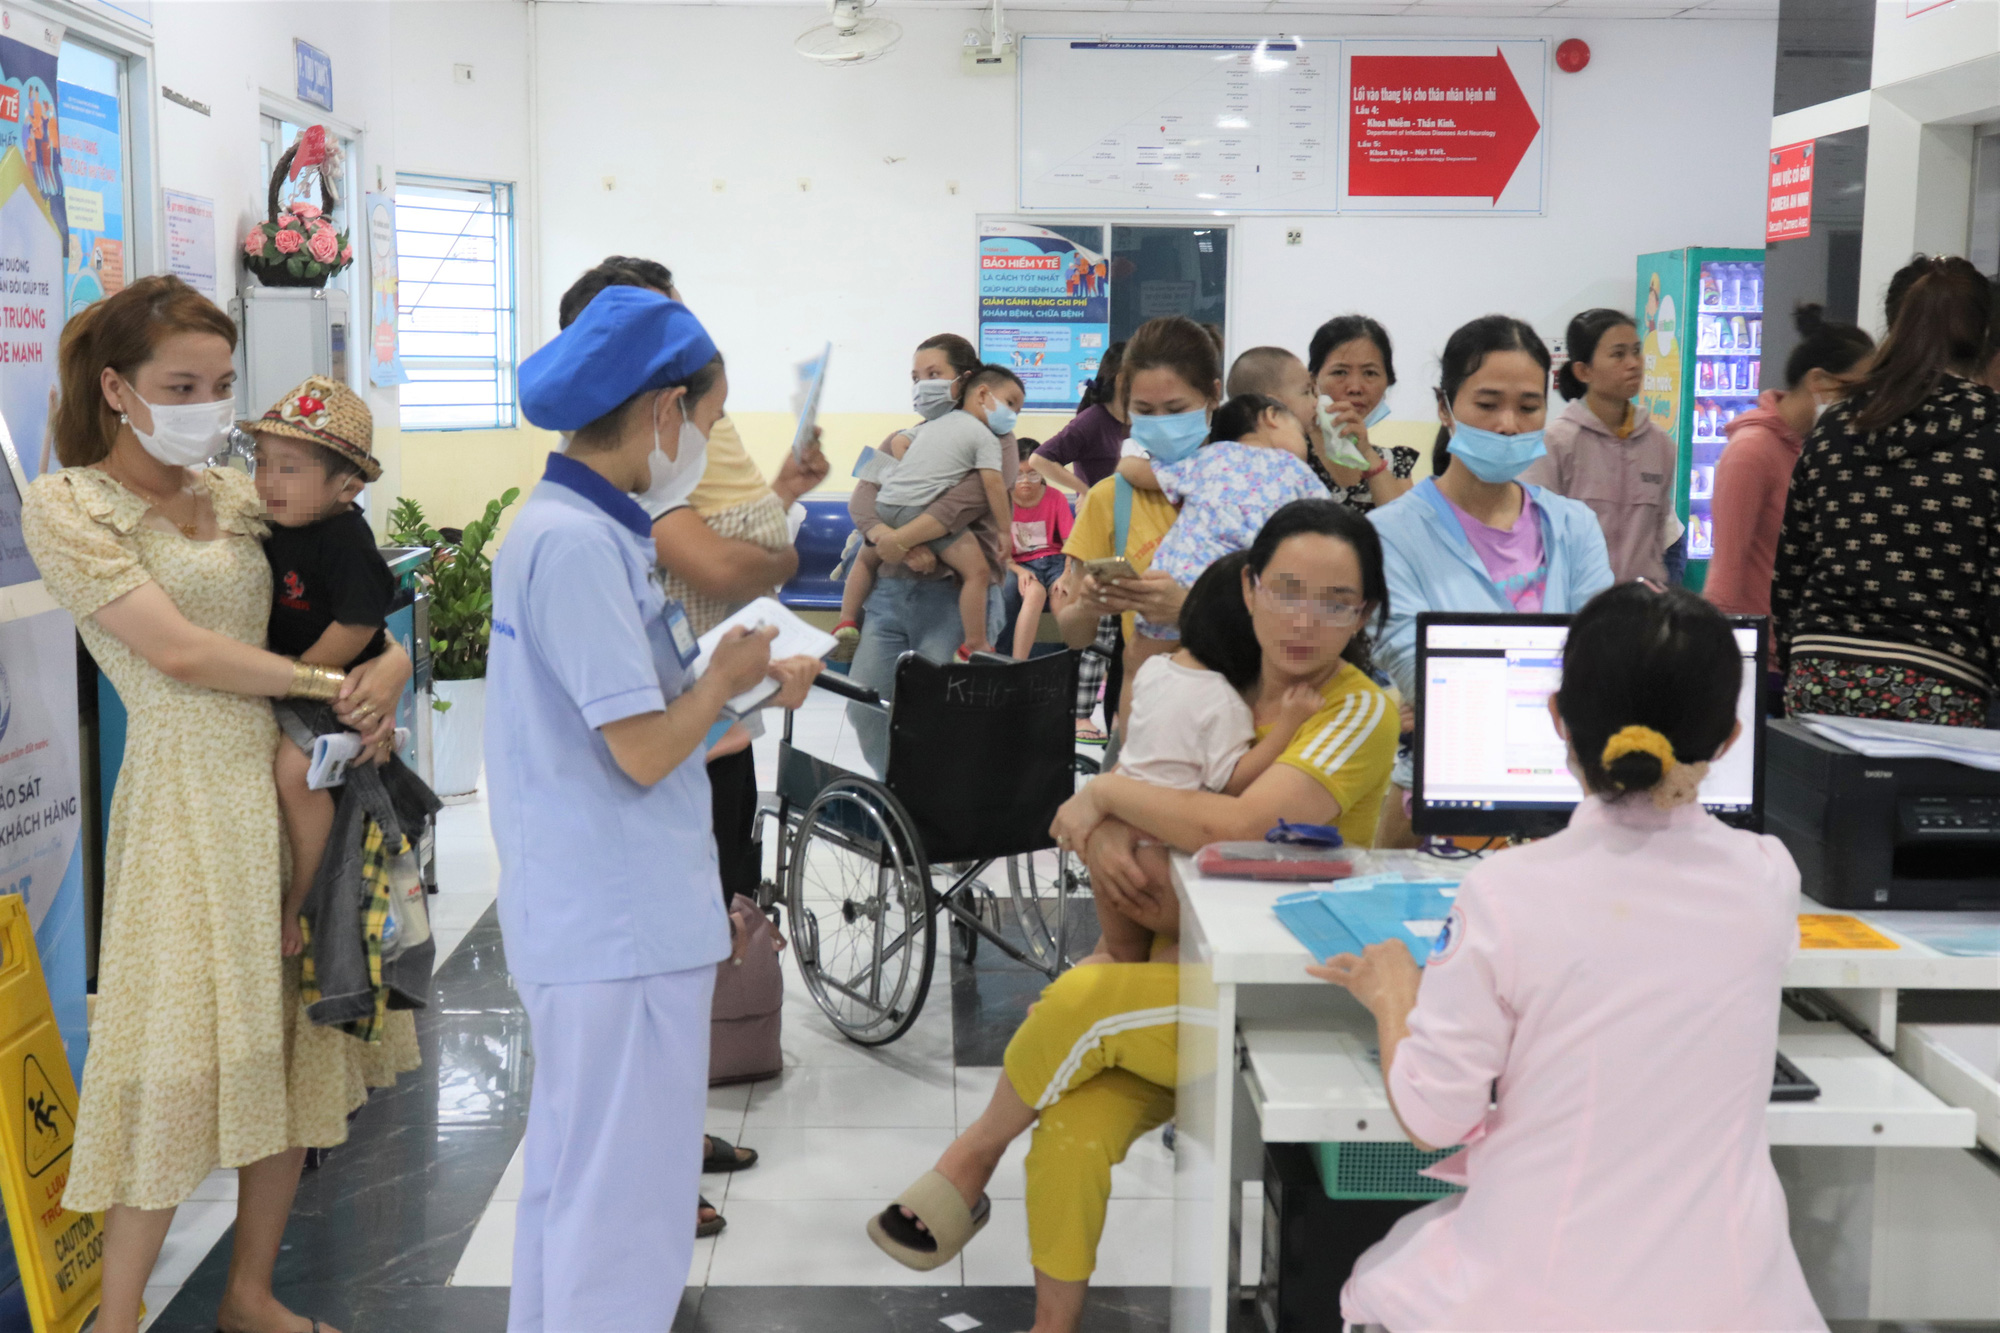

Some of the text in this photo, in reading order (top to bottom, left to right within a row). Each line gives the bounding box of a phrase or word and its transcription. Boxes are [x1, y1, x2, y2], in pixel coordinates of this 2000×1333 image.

[1367, 87, 1379, 101] vào
[1380, 87, 1401, 104] thang
[1403, 87, 1412, 104] bộ
[1413, 87, 1427, 101] cho
[1428, 87, 1445, 101] thân
[1446, 87, 1464, 101] nhân
[1465, 87, 1483, 104] bệnh
[1484, 87, 1496, 101] nhi
[5, 90, 18, 118] TẾ
[1371, 105, 1379, 114] 4:
[1367, 119, 1386, 127] Khoa
[1387, 117, 1411, 127] Nhiễm
[1437, 119, 1456, 127] Kinh.
[1469, 130, 1496, 138] Neurology
[1770, 194, 1790, 212] CAMERA
[1790, 193, 1797, 209] AN
[982, 256, 1059, 268] BẢO HIỂM Y TẾ
[995, 272, 1018, 281] CÁCH
[22, 279, 37, 295] GIÚP
[982, 284, 1001, 293] GIÚP
[1002, 284, 1027, 293] NGƯỜI
[1028, 284, 1049, 294] BỆNH
[982, 298, 1004, 306] GIẢM
[1005, 298, 1030, 306] GÁNH
[1031, 298, 1055, 307] NẶNG
[1073, 298, 1088, 306] PHÍ
[982, 309, 1007, 317] KHÁM
[1061, 309, 1084, 319] BỆNH
[12, 341, 42, 367] MẠNH
[1864, 770, 1893, 778] brother
[18, 775, 42, 804] SÁT
[44, 796, 76, 828] HÀNG
[54, 1212, 96, 1262] CAUTION
[55, 1258, 78, 1294] WET
